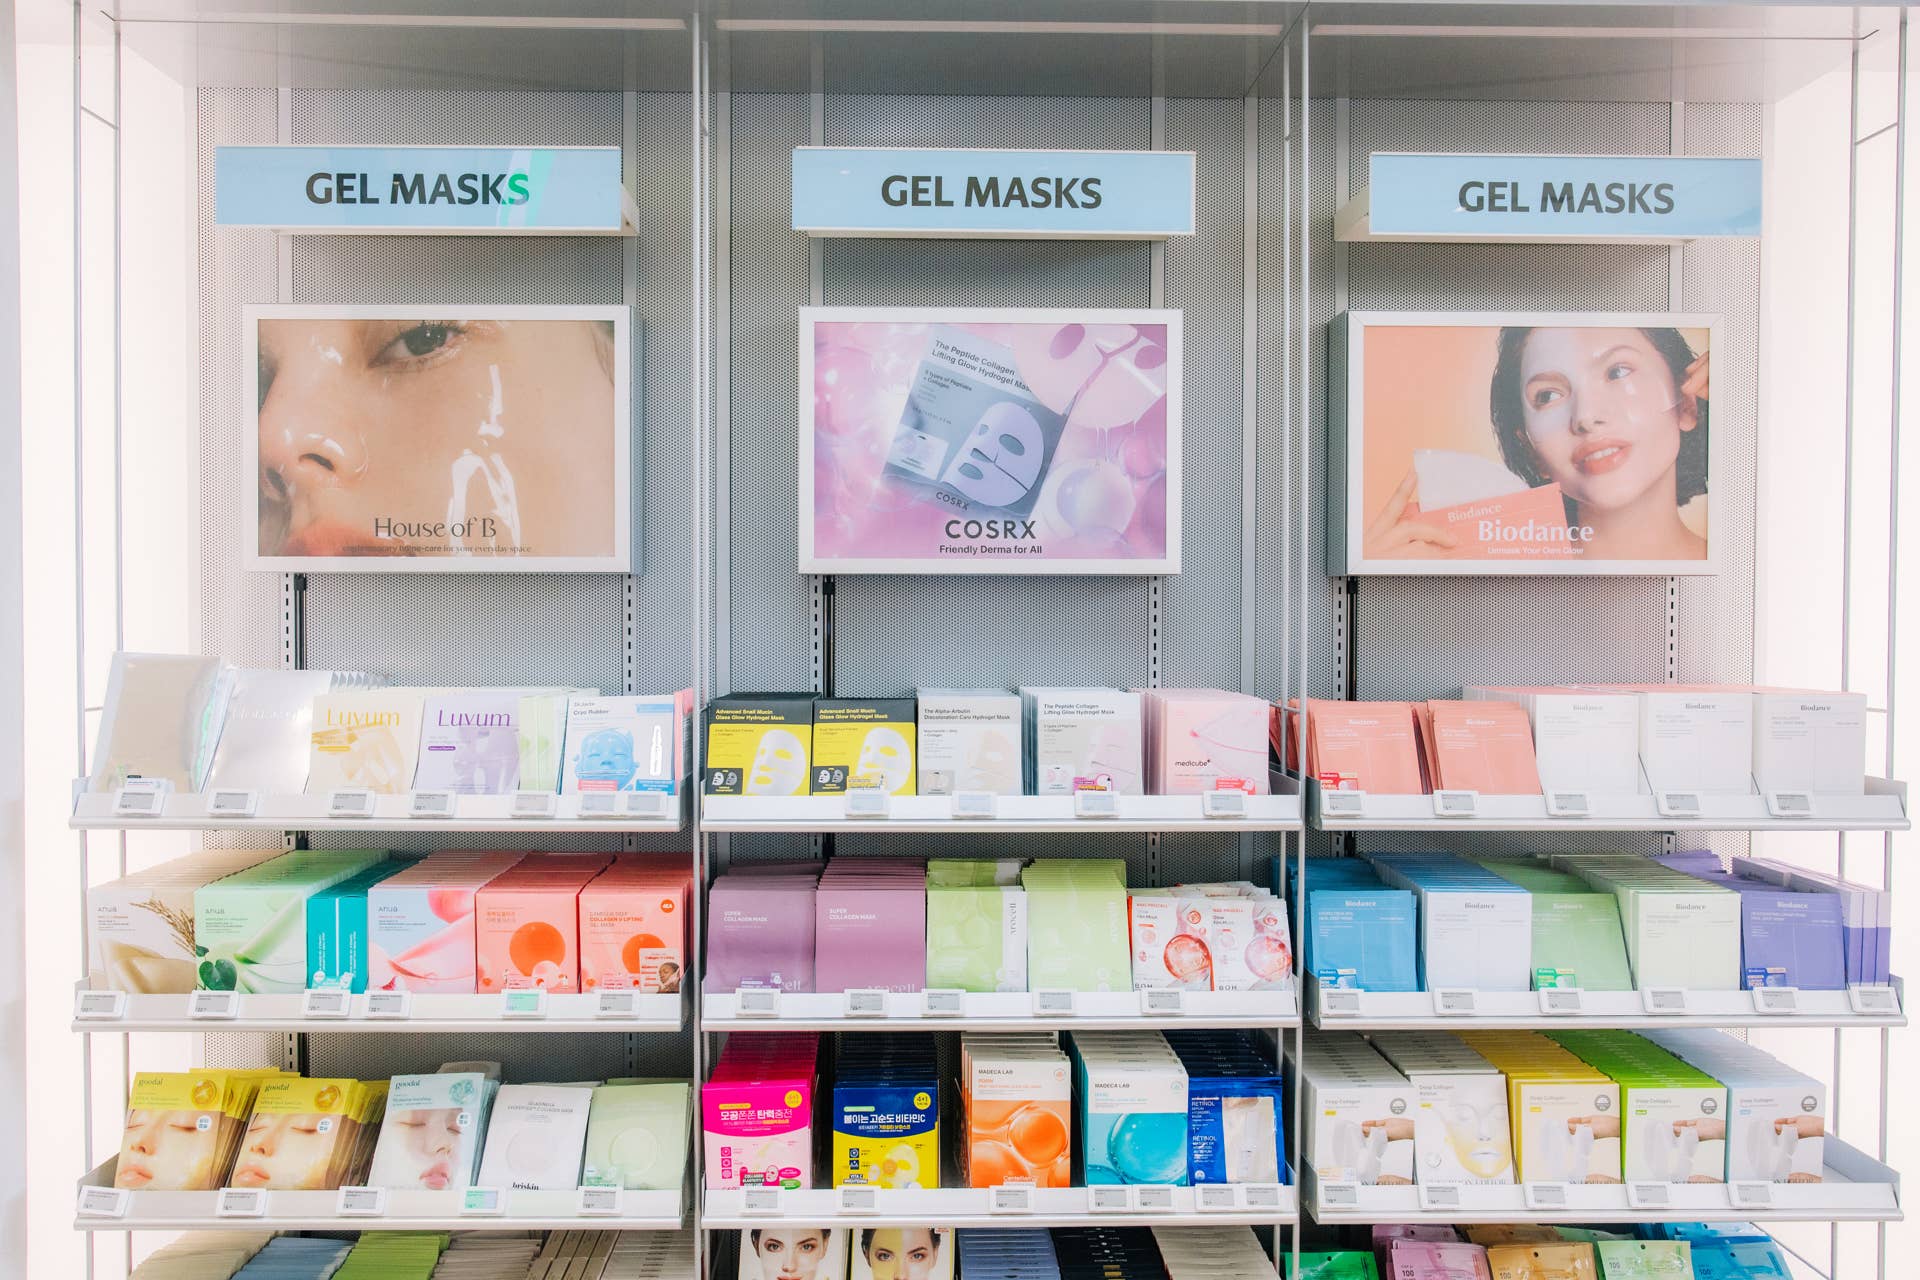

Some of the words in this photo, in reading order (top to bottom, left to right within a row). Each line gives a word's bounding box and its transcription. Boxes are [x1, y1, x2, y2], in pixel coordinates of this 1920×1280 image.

[305, 172, 380, 205] GEL
[389, 172, 530, 206] MASKS
[881, 175, 954, 208] GEL
[964, 175, 1103, 210] MASKS
[1458, 181, 1530, 213] GEL
[1540, 182, 1675, 215] MASKS
[935, 339, 950, 351] The
[950, 346, 980, 363] Peptide
[980, 357, 1016, 377] Collagen
[931, 349, 957, 365] Lifting
[957, 357, 978, 373] Glow
[978, 366, 1014, 386] Hydrogel
[935, 491, 970, 511] COSRX
[1447, 503, 1503, 522] Biodance
[374, 517, 445, 538] House
[451, 516, 477, 538] of
[481, 517, 497, 538] B
[945, 520, 1037, 540] COSRX
[1478, 519, 1594, 542] Biodance
[939, 545, 978, 556] Friendly
[980, 545, 1012, 554] Derma
[1014, 544, 1028, 554] for
[1029, 545, 1042, 554] All
[327, 709, 400, 727] Luvum
[438, 709, 511, 727] Luvum
[1464, 902, 1496, 910] Biodance
[1675, 903, 1707, 911] Biodance
[1009, 902, 1017, 936] arocell
[138, 1078, 164, 1087] goodal
[264, 1083, 290, 1092] goodal
[395, 1080, 420, 1090] goodal
[869, 1114, 895, 1124] 고순도
[895, 1114, 926, 1124] 비타민C
[512, 1181, 539, 1191] briskin
[1401, 1269, 1415, 1278] 100
[1609, 1262, 1621, 1270] 100
[1499, 1271, 1512, 1280] 100
